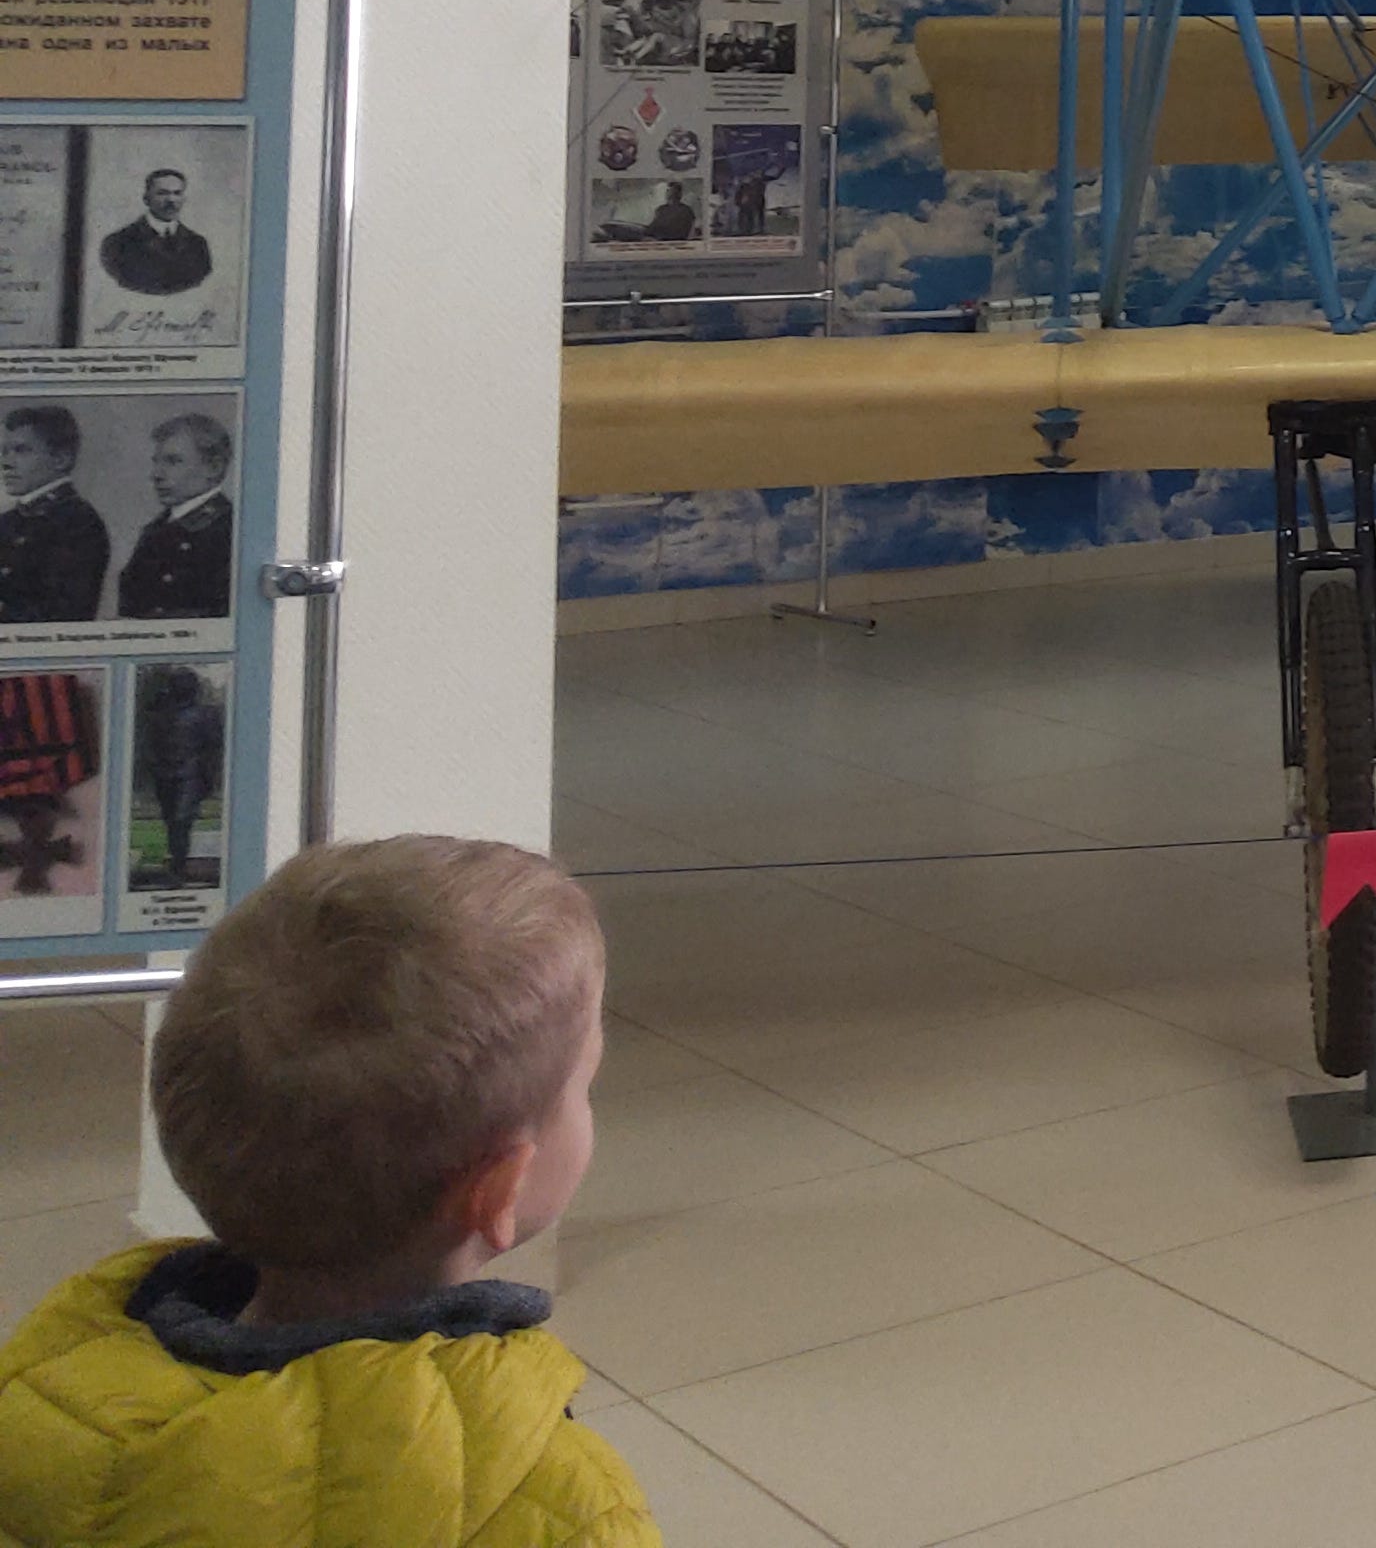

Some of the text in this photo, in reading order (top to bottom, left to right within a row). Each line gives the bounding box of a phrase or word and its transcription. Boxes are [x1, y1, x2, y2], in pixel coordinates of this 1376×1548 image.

[131, 15, 212, 28] захвате
[42, 38, 92, 50] одна
[106, 39, 128, 49] из
[141, 39, 209, 50] малых
